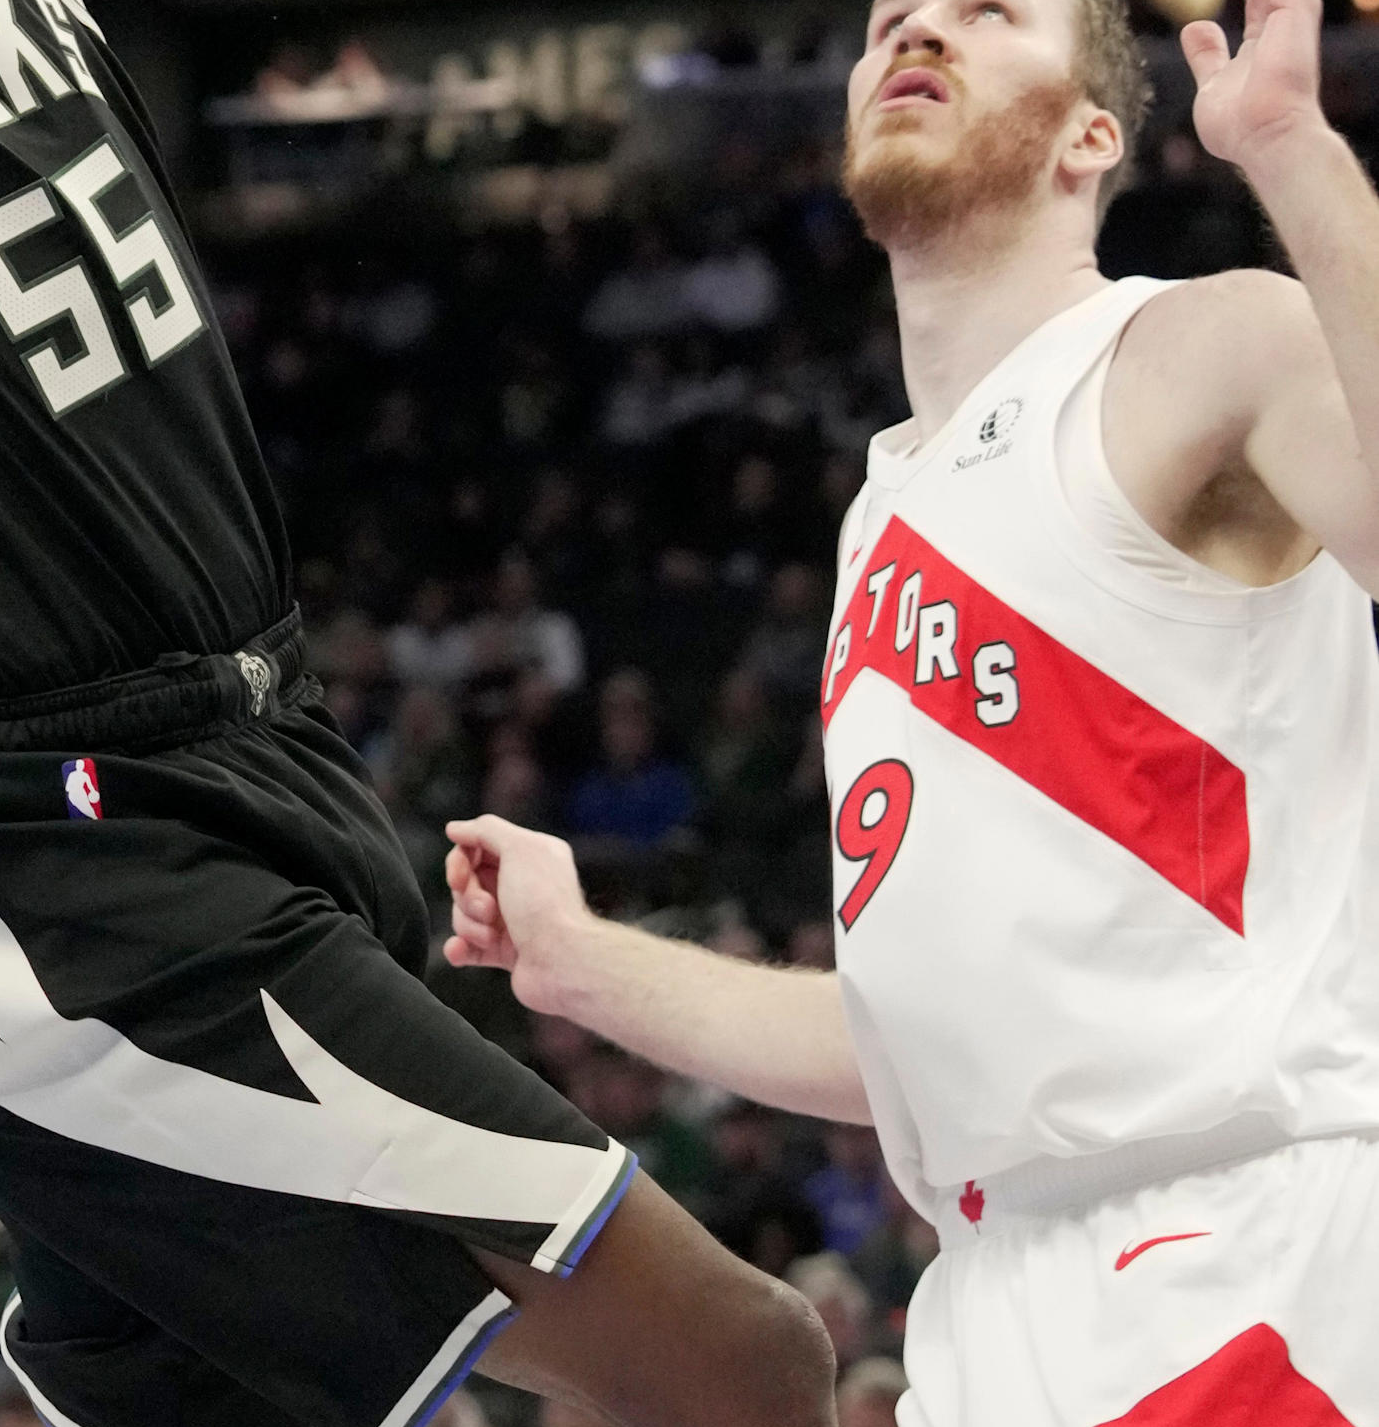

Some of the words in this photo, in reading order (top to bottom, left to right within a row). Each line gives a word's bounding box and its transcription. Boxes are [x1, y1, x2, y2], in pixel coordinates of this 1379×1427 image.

[951, 454, 983, 473] Sun
[823, 559, 1021, 728] PTORS
[835, 758, 914, 934] 9
